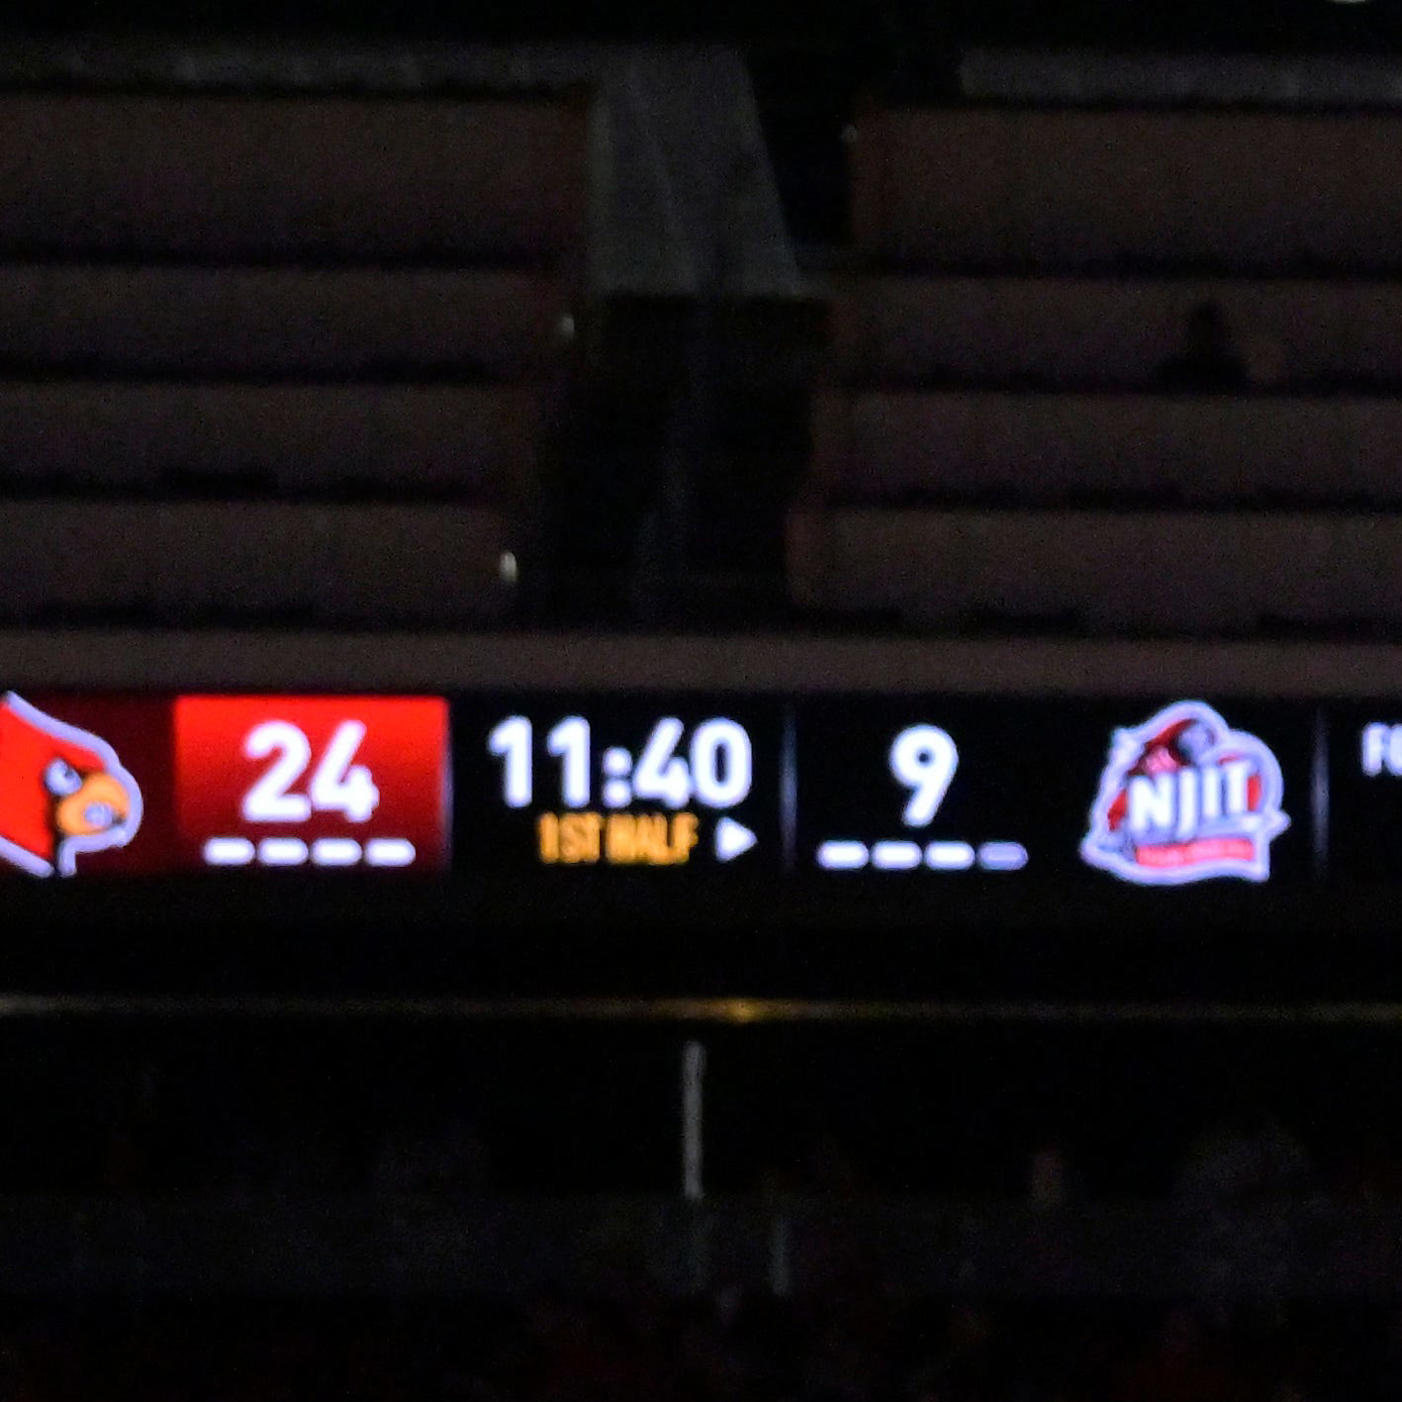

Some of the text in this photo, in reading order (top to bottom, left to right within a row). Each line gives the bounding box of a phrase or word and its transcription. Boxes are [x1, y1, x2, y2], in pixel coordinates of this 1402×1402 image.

[241, 720, 379, 824] 24
[488, 716, 752, 809] 11:40
[889, 725, 958, 827] 9
[1127, 760, 1253, 839] NJIT
[537, 812, 699, 865] 1ST HALF
